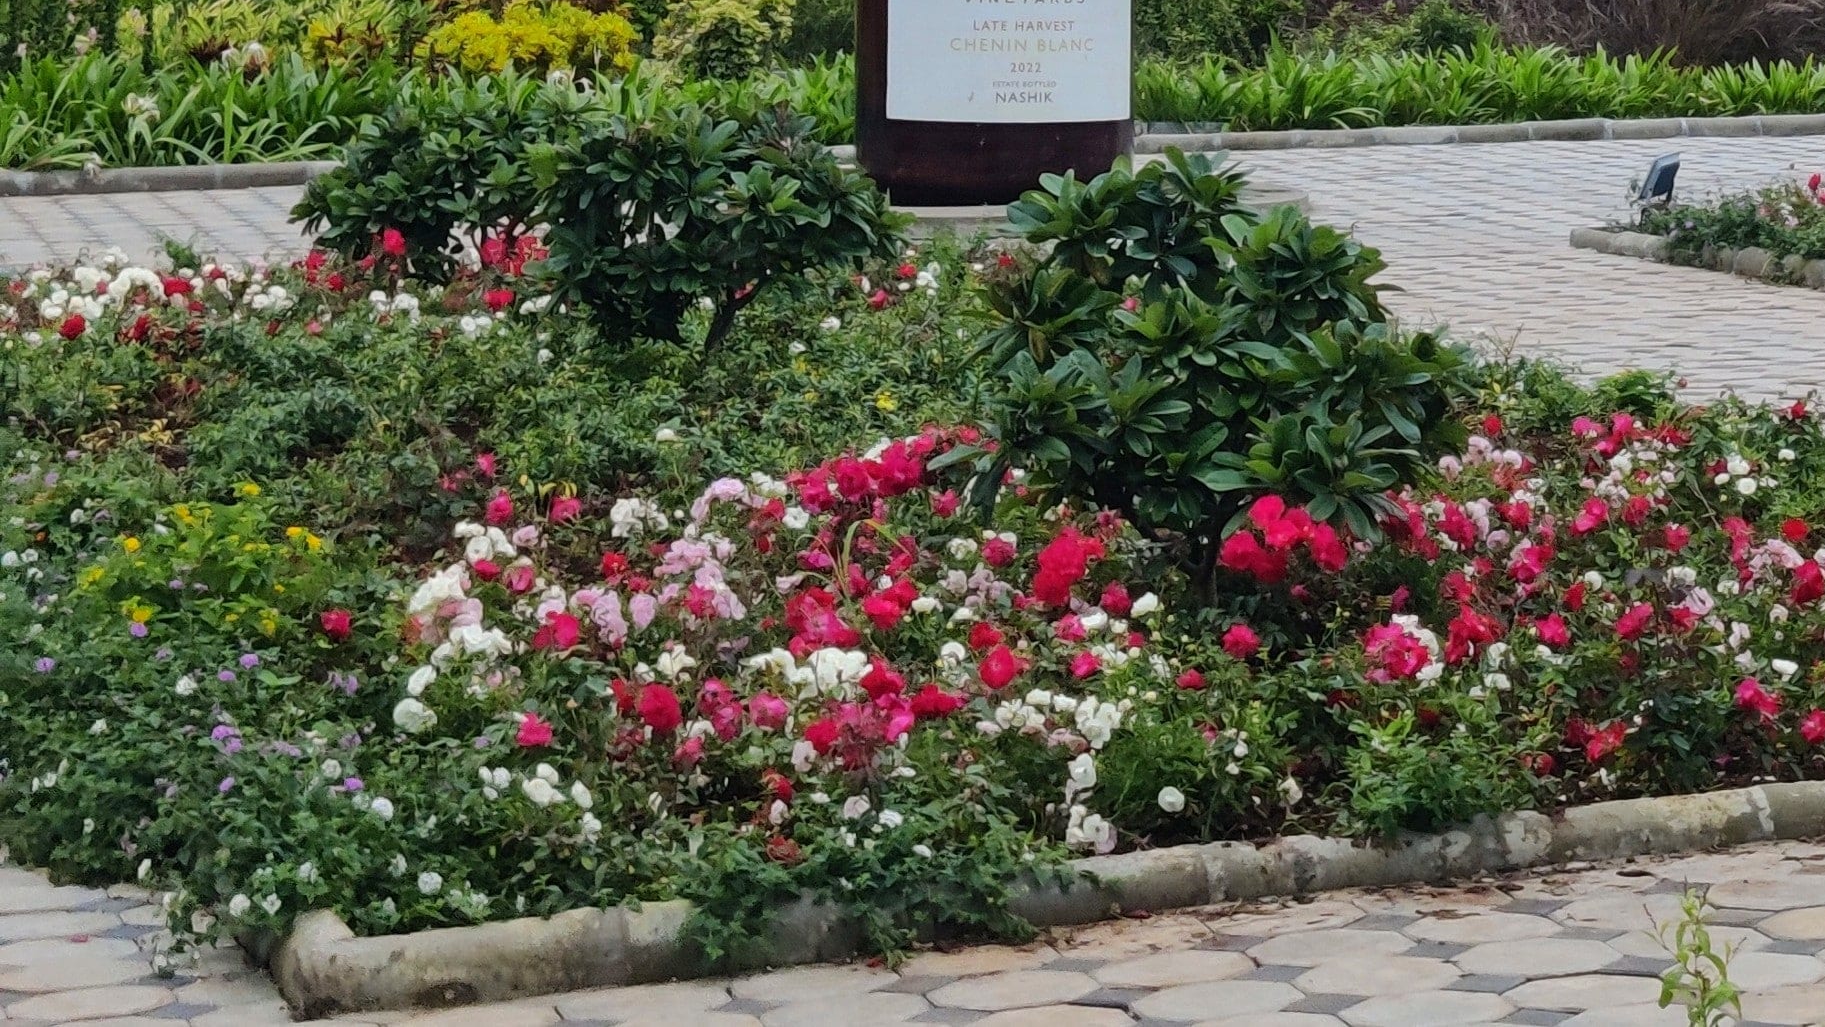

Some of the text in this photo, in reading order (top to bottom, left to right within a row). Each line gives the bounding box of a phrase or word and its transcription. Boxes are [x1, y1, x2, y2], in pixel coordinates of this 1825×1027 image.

[973, 20, 1075, 31] LATE HARVEST
[950, 37, 1095, 52] CHENIN BLANC
[1010, 62, 1042, 73] 2022
[995, 92, 1053, 104] NASHIK
